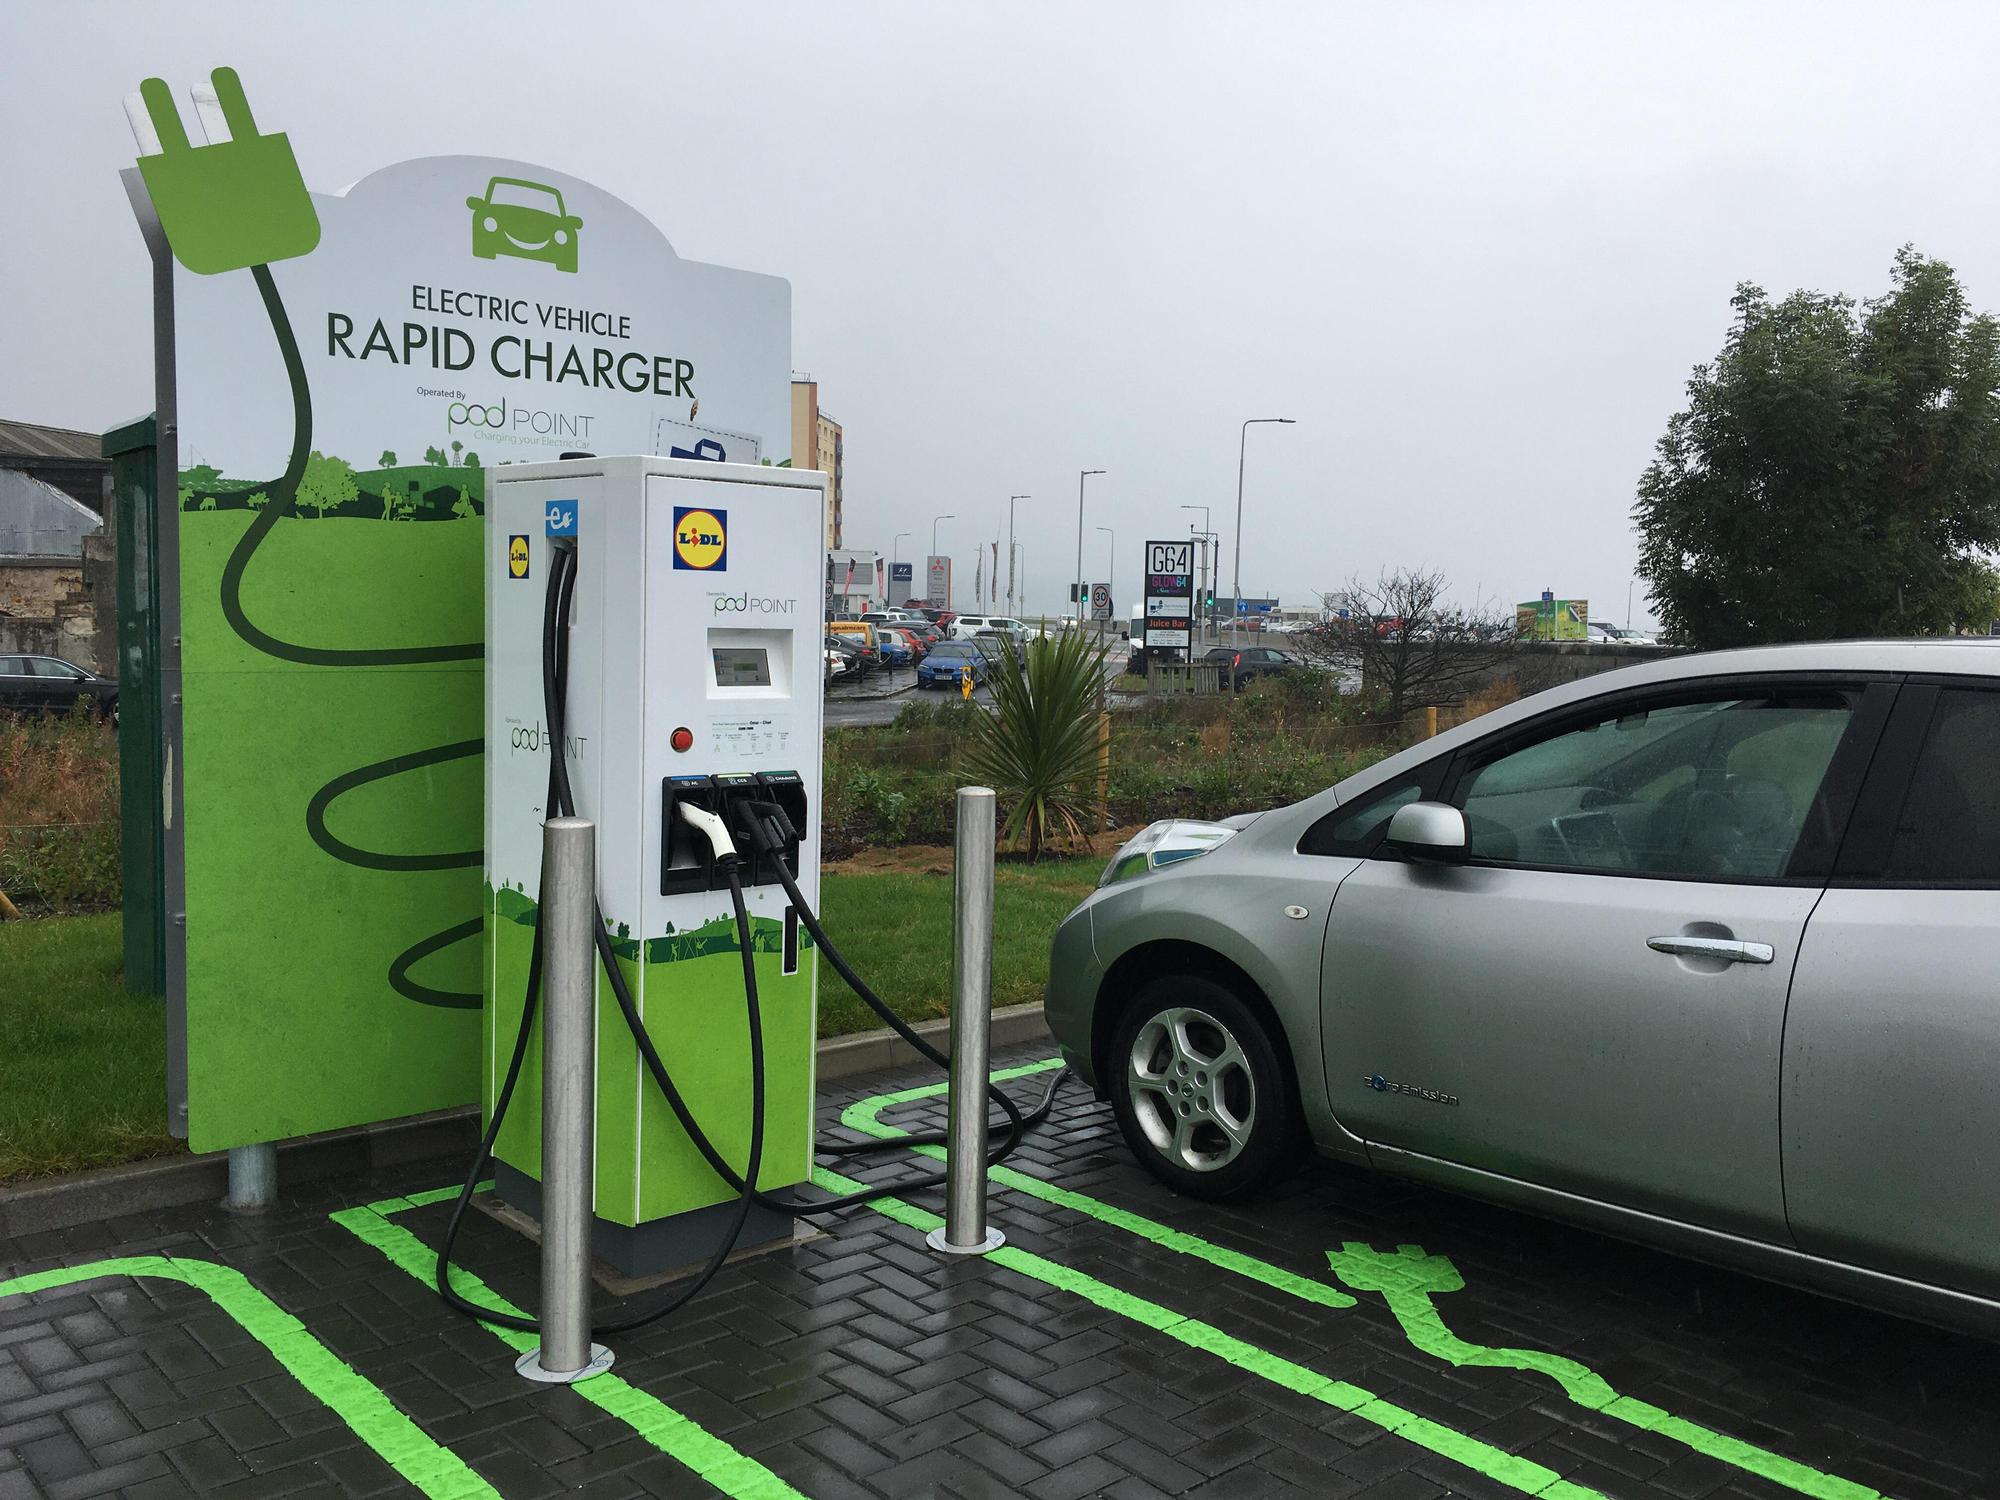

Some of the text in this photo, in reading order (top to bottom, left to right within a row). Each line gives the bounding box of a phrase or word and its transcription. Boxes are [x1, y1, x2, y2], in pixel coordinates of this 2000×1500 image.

[412, 285, 631, 339] ELECTRIC VEHICLE
[327, 312, 695, 399] RAPID CHARGER
[416, 386, 466, 400] Operated By
[513, 409, 595, 437] POINT
[474, 430, 590, 449] Charging your Electric Car
[1153, 546, 1186, 573] G64
[750, 598, 797, 614] POINT
[1095, 592, 1106, 602] 30
[1149, 619, 1187, 628] Juice Bar
[542, 731, 588, 760] PINT
